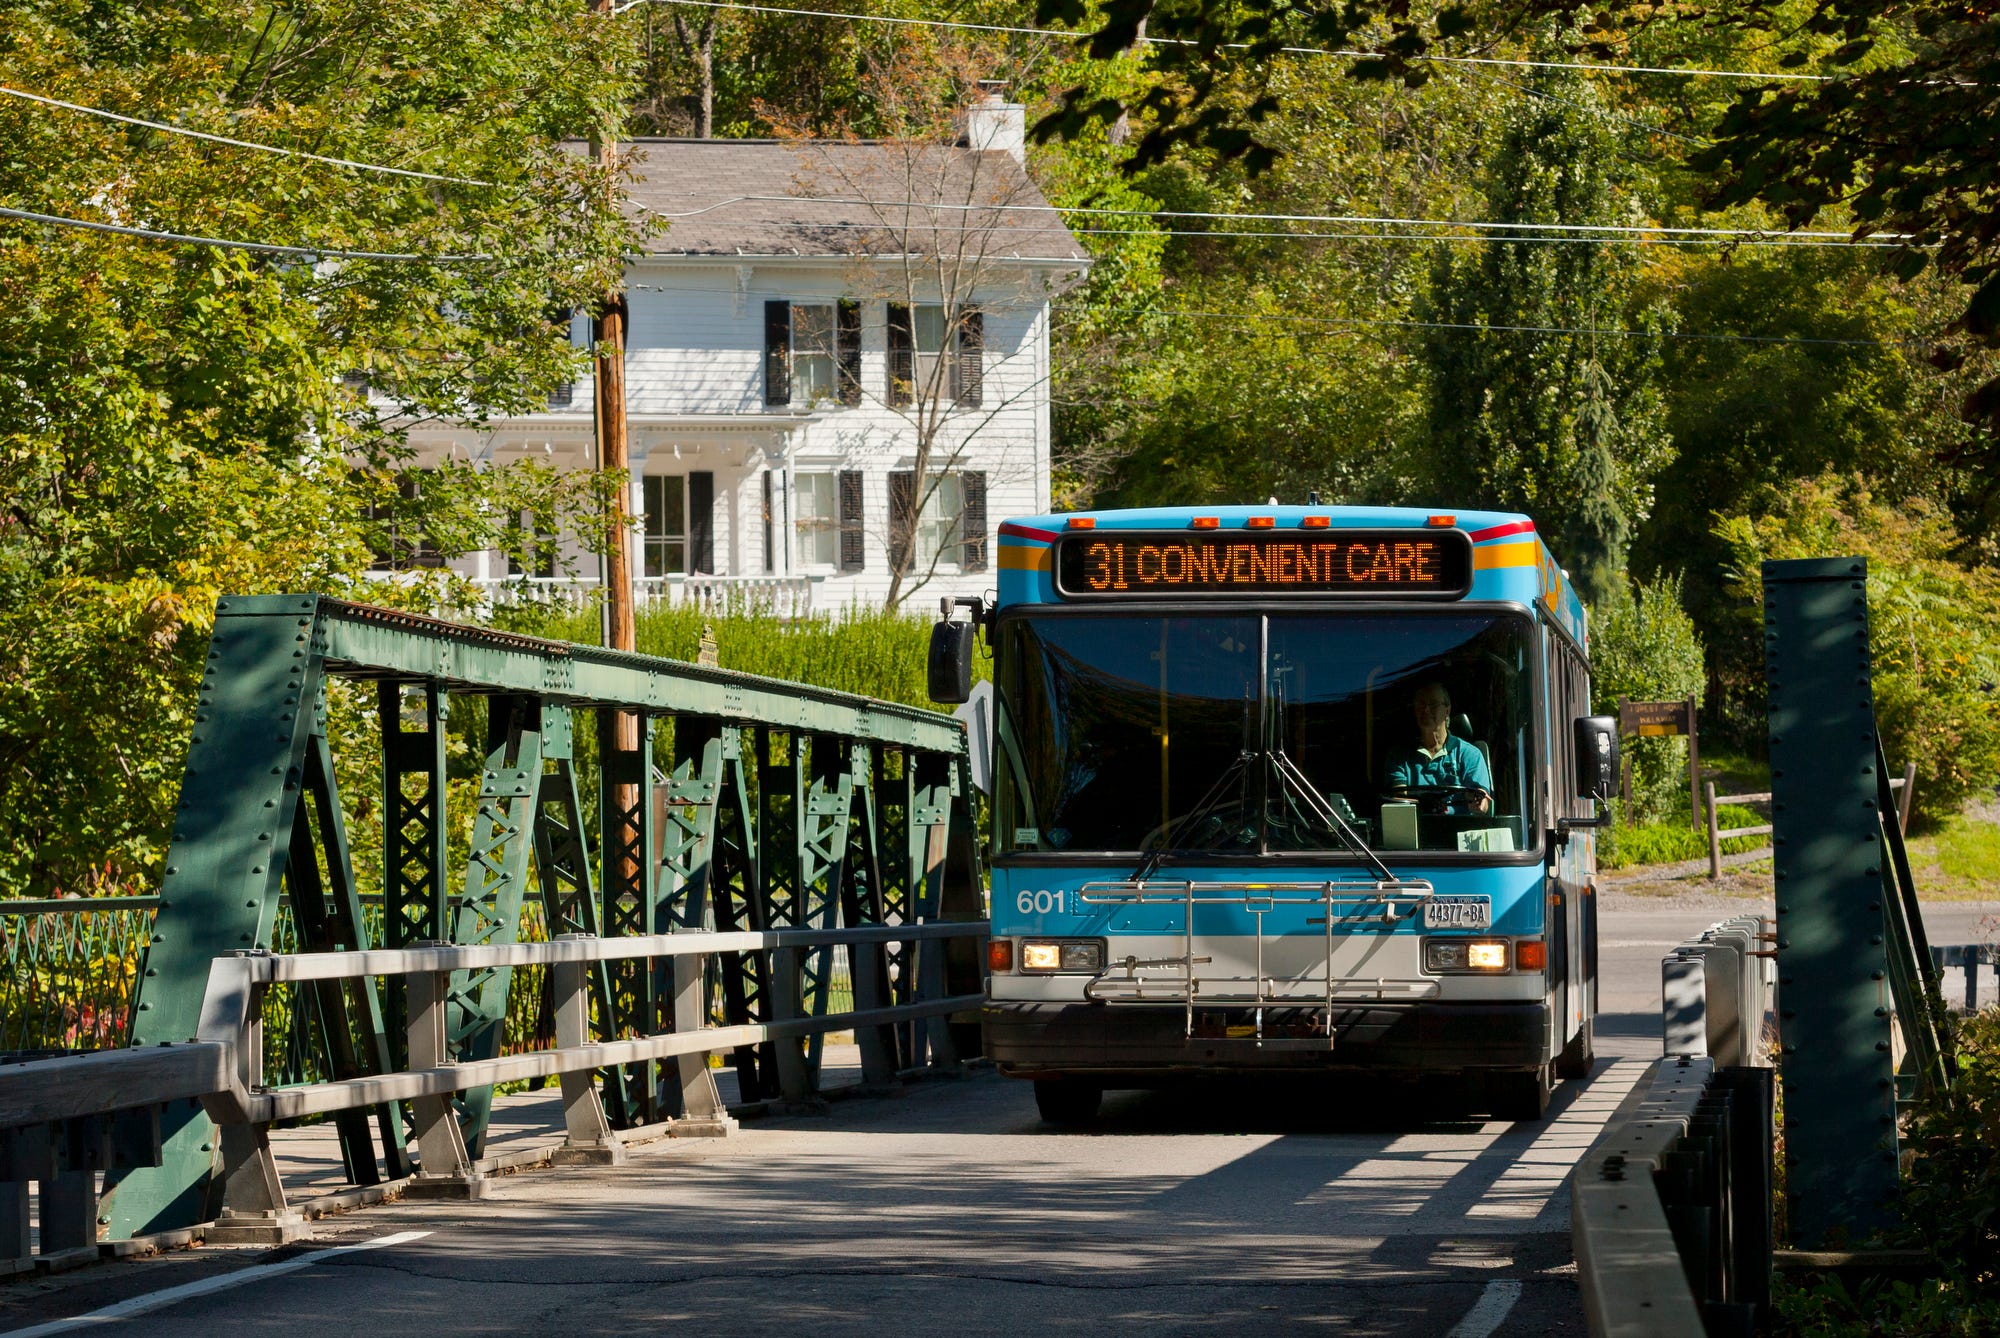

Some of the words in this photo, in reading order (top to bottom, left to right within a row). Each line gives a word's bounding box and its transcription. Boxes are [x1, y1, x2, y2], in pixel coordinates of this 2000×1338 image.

[1088, 543, 1128, 589] 31
[1136, 543, 1337, 583] CONVENIENT
[1346, 543, 1434, 581] CARE
[1016, 889, 1065, 914] 601
[1440, 896, 1455, 904] NEW
[1457, 896, 1474, 904] YORK
